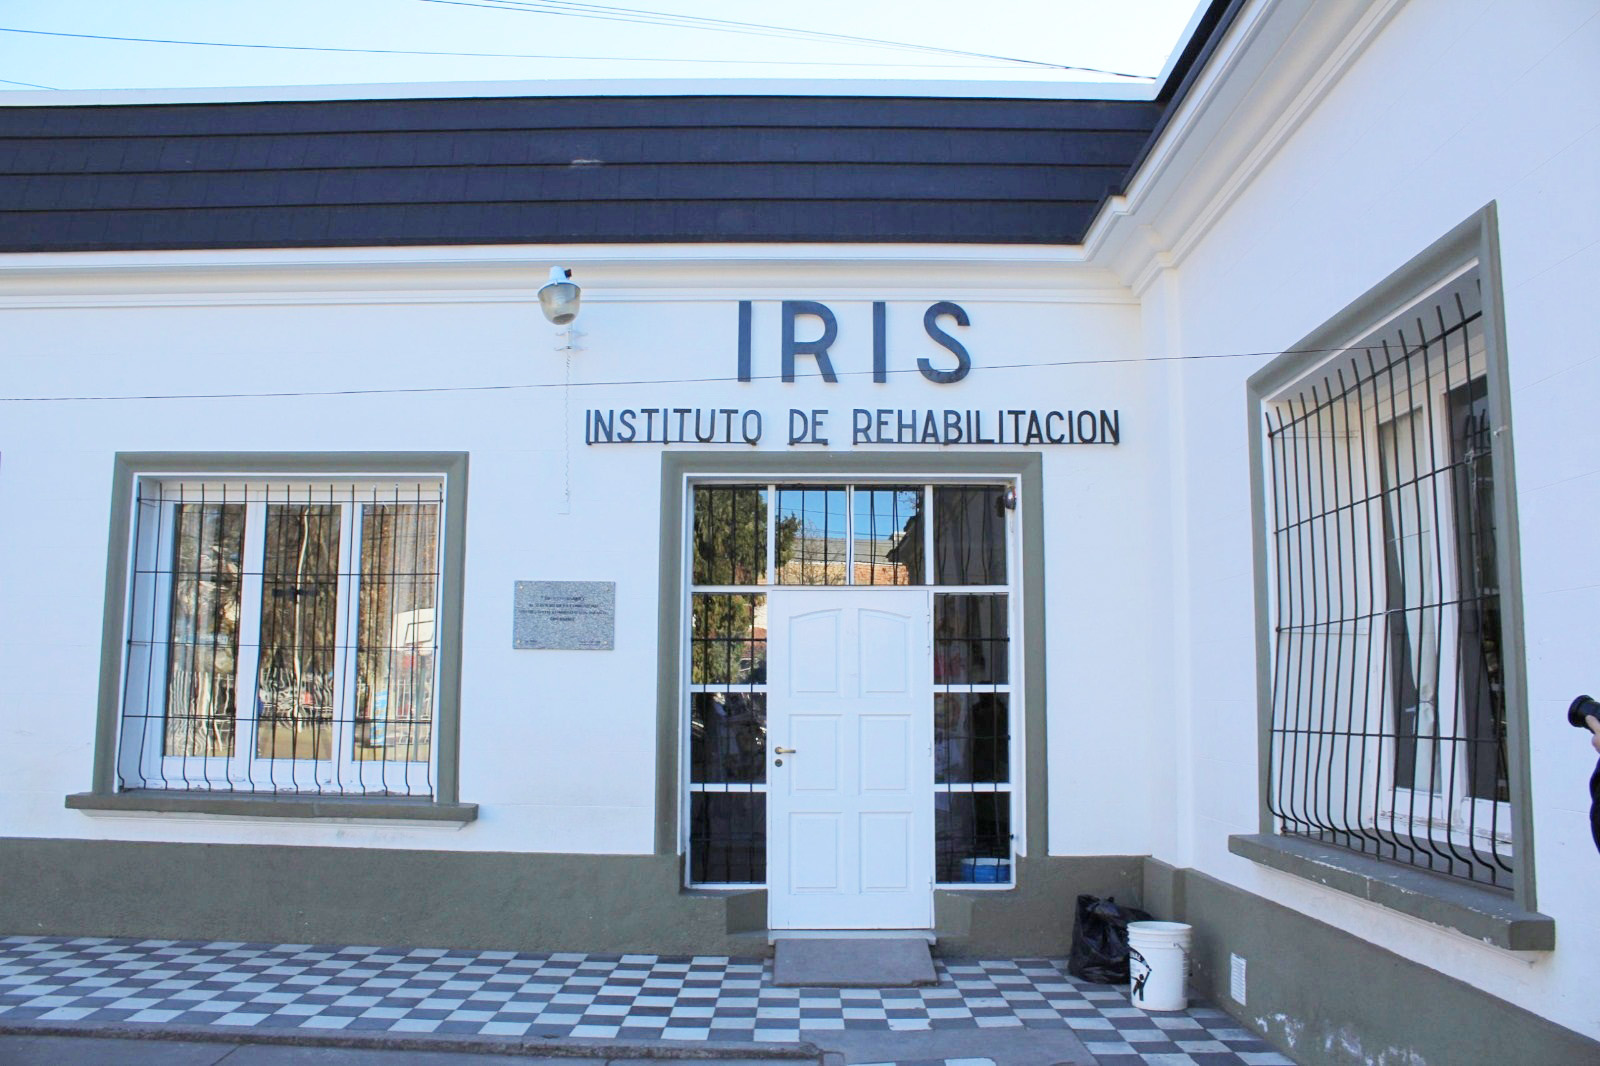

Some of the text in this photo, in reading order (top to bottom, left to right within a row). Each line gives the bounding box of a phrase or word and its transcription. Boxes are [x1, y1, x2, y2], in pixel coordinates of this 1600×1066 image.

[738, 300, 971, 384] IRIS
[586, 408, 1120, 445] INSTITUTO DE REHABILITACION
